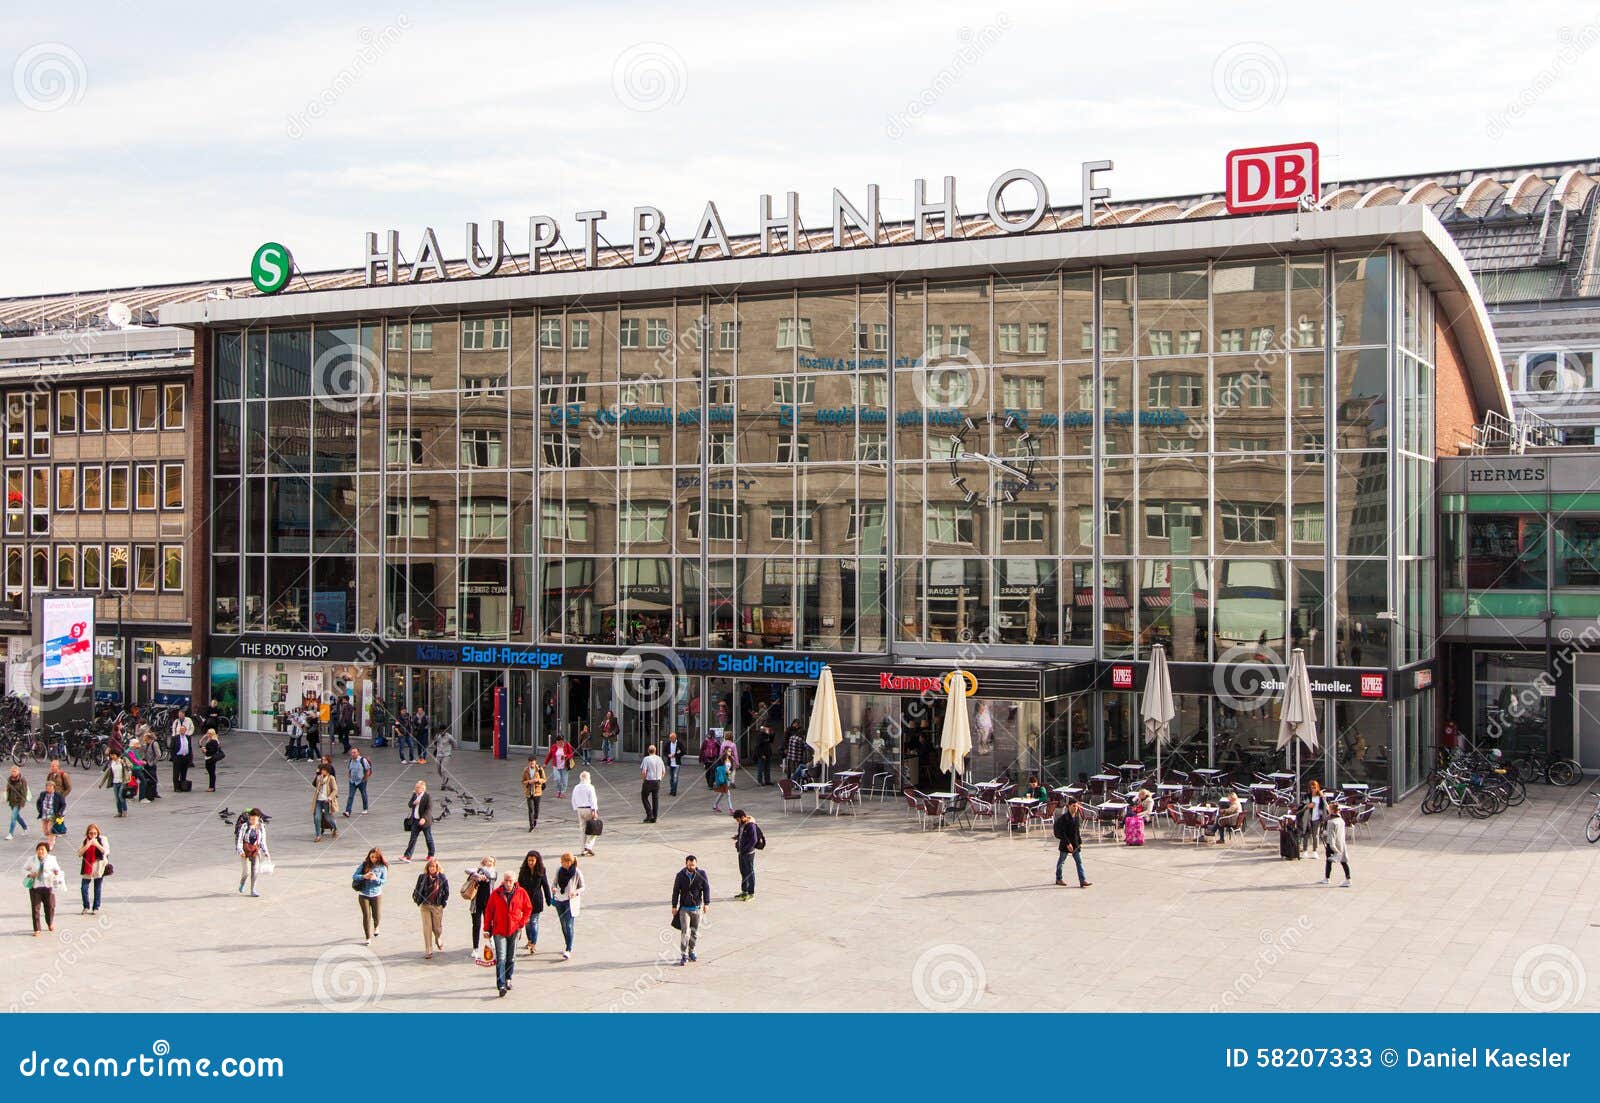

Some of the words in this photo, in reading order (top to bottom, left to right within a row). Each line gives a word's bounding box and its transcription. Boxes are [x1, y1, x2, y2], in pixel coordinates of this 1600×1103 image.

[1237, 153, 1307, 203] DB
[364, 159, 1114, 284] HAUPTBAHNHOF
[258, 248, 282, 287] S
[240, 643, 262, 655] THE
[265, 643, 296, 656] BODY
[297, 645, 329, 658] SHOP
[416, 643, 458, 662] Kölner
[461, 645, 564, 669] Stadt-Anzeiger
[163, 659, 181, 668] Change
[879, 671, 943, 695] Kamps
[1308, 679, 1353, 693] chneller.
